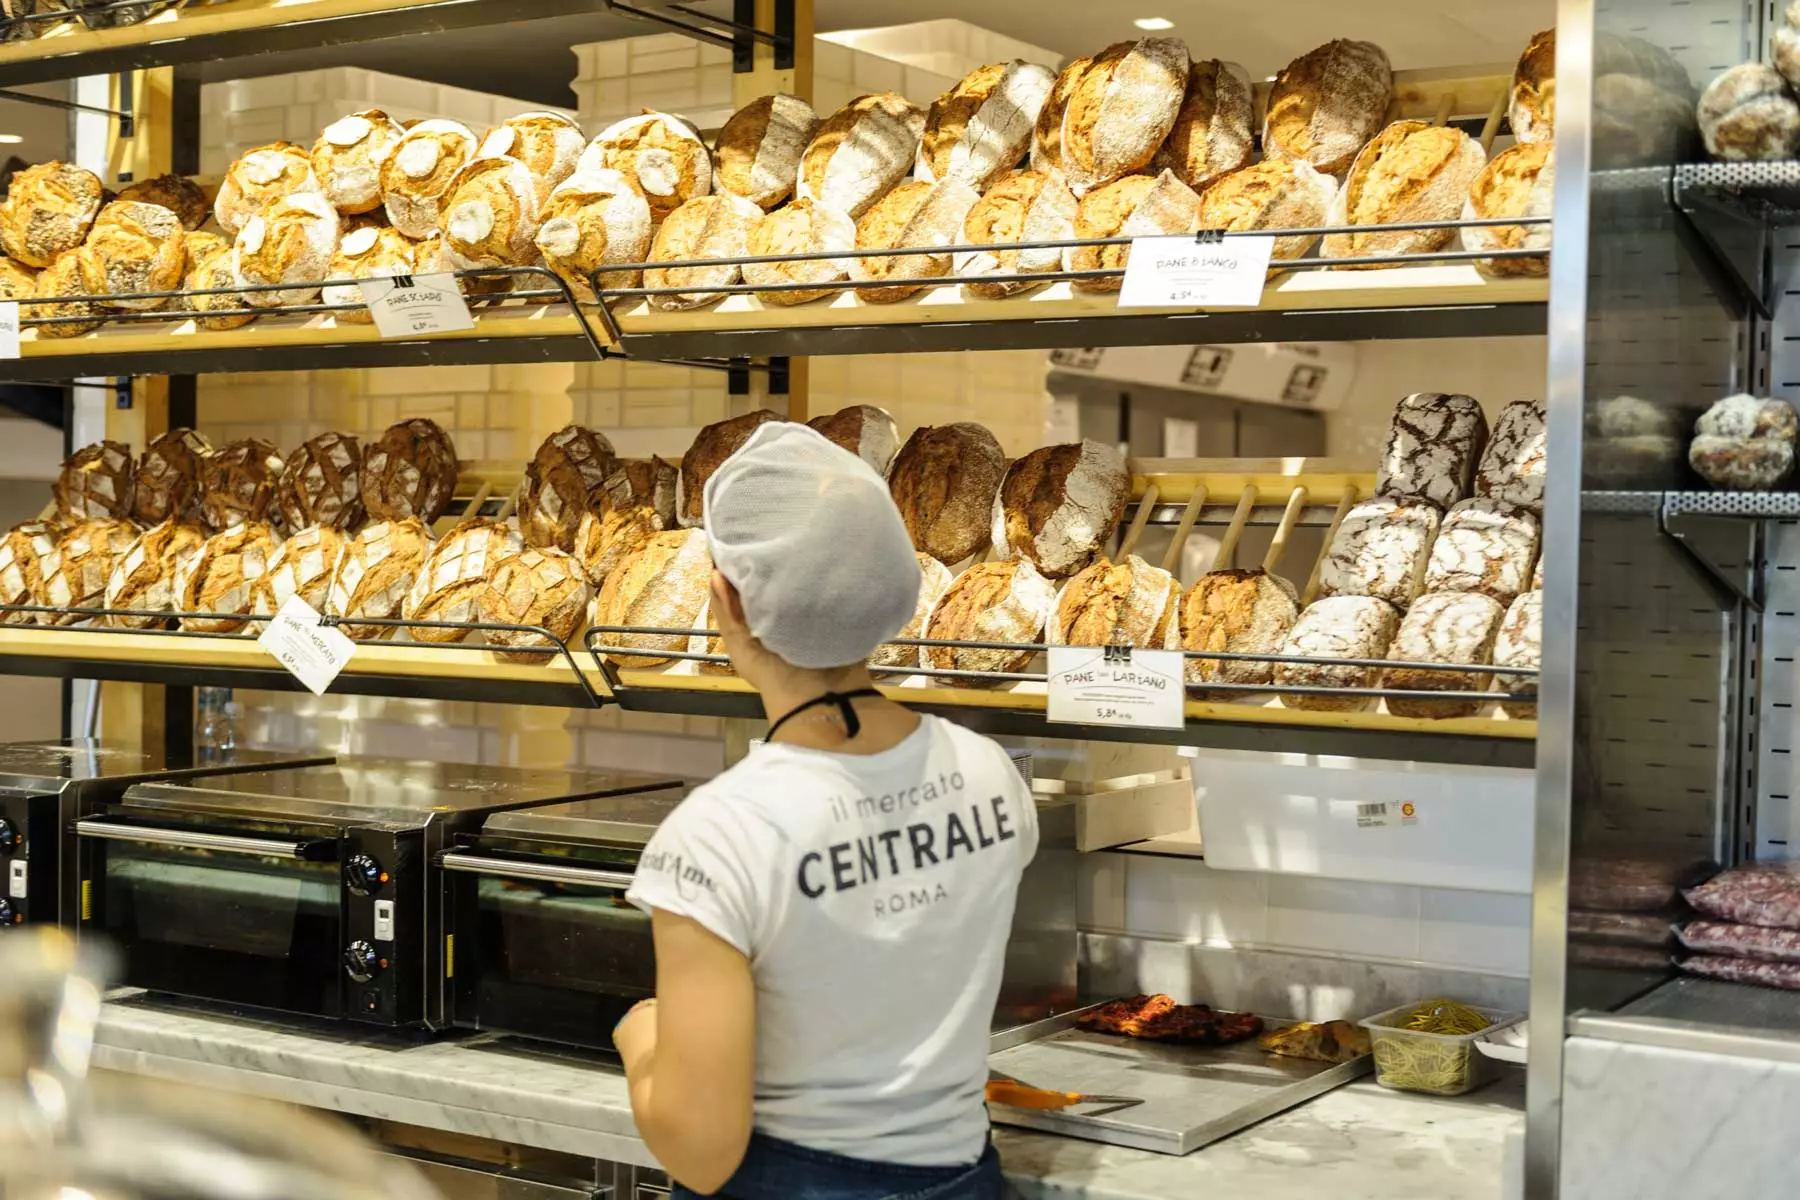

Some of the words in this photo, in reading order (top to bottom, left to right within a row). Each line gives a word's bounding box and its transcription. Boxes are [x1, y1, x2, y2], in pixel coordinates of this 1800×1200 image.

[1063, 672, 1095, 685] PANE
[1113, 671, 1167, 690] LARIANO
[827, 793, 850, 823] il
[856, 771, 966, 819] mercato
[798, 795, 1016, 900] CENTRALE
[874, 883, 949, 918] ROMA
